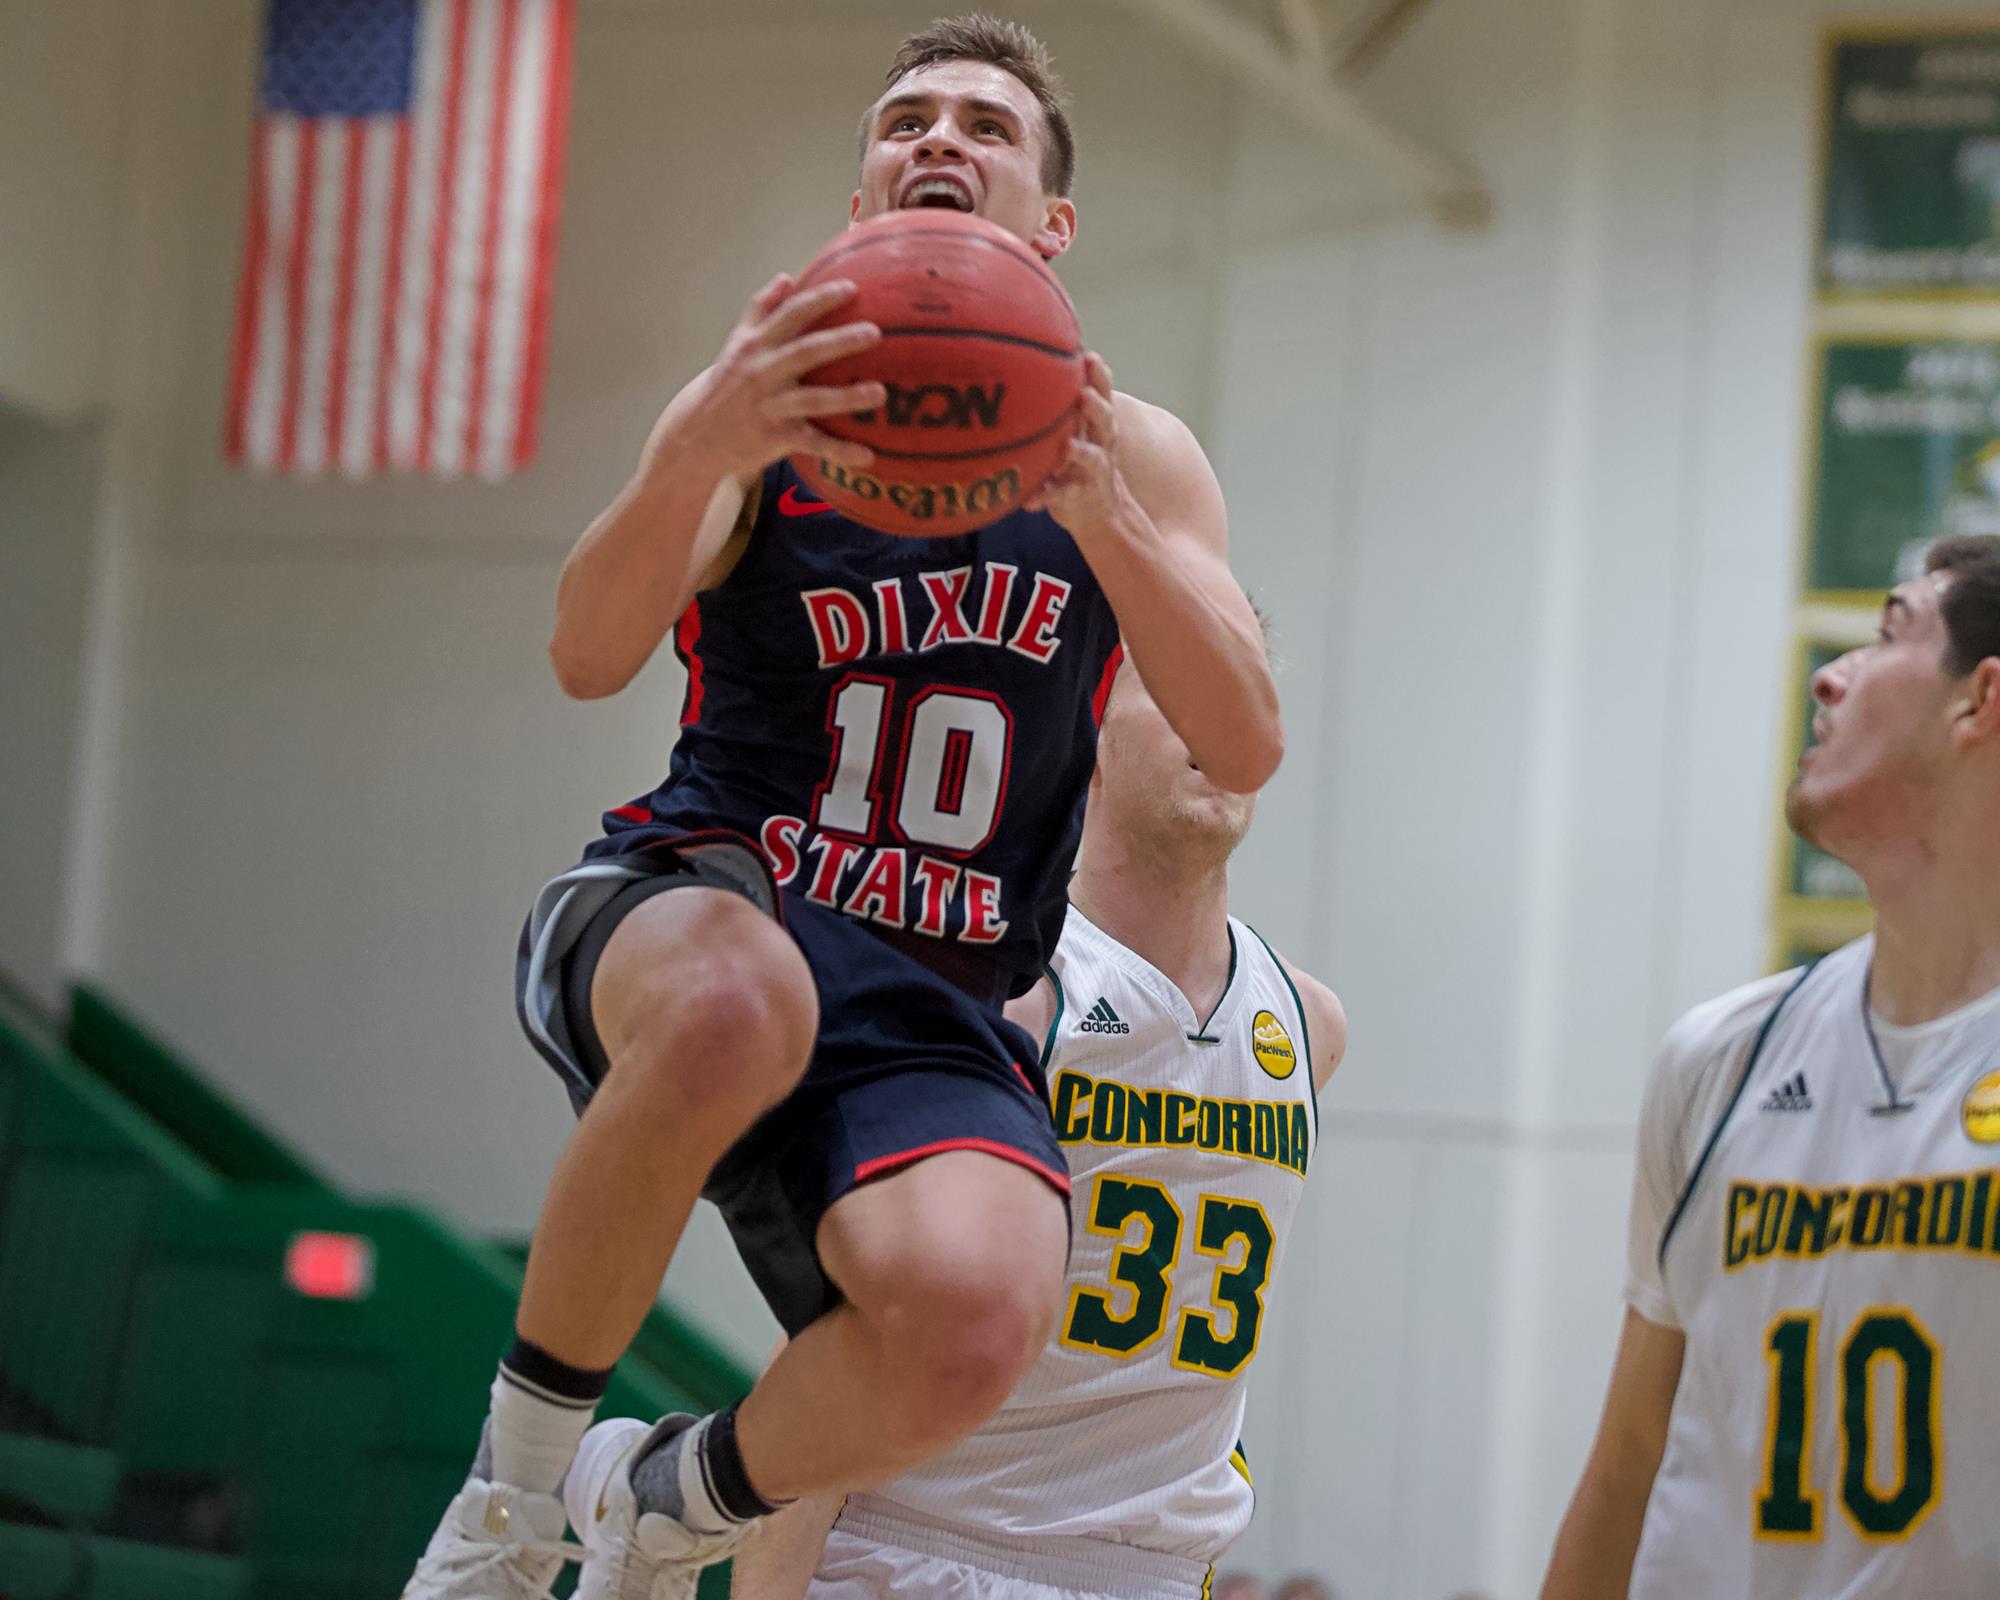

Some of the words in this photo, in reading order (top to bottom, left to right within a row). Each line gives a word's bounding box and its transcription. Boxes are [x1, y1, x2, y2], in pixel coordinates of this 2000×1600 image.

[801, 561, 1072, 668] DIXIE
[810, 672, 1014, 859] 10
[760, 815, 1009, 944] STATE
[1080, 1019, 1130, 1034] adidas
[1053, 1068, 1309, 1180] CONCORDIA
[1060, 1173, 1277, 1379] 33
[1752, 1307, 1945, 1544] 10
